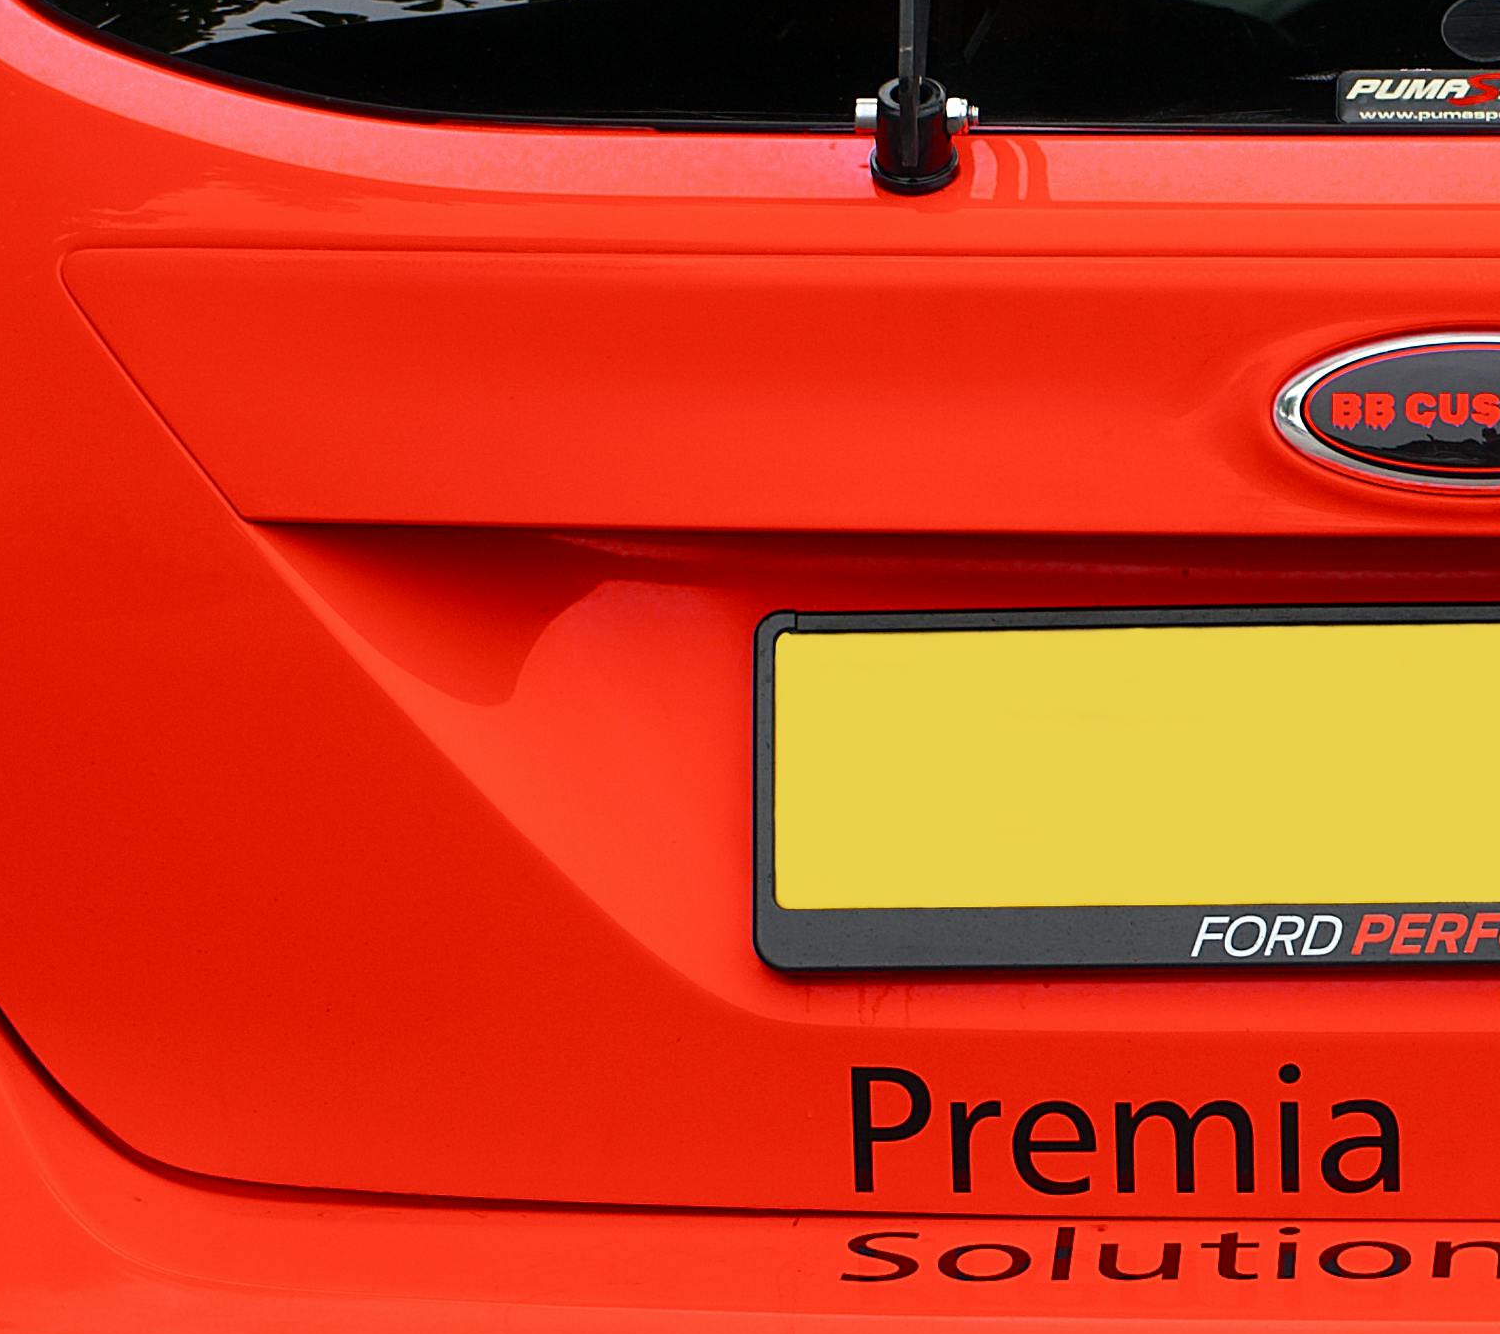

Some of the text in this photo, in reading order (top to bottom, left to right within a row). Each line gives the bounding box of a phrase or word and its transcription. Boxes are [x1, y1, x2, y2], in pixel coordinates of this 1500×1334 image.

[1331, 392, 1396, 431] BB
[1190, 914, 1343, 958] FORD
[850, 1063, 1402, 1196] Premia
